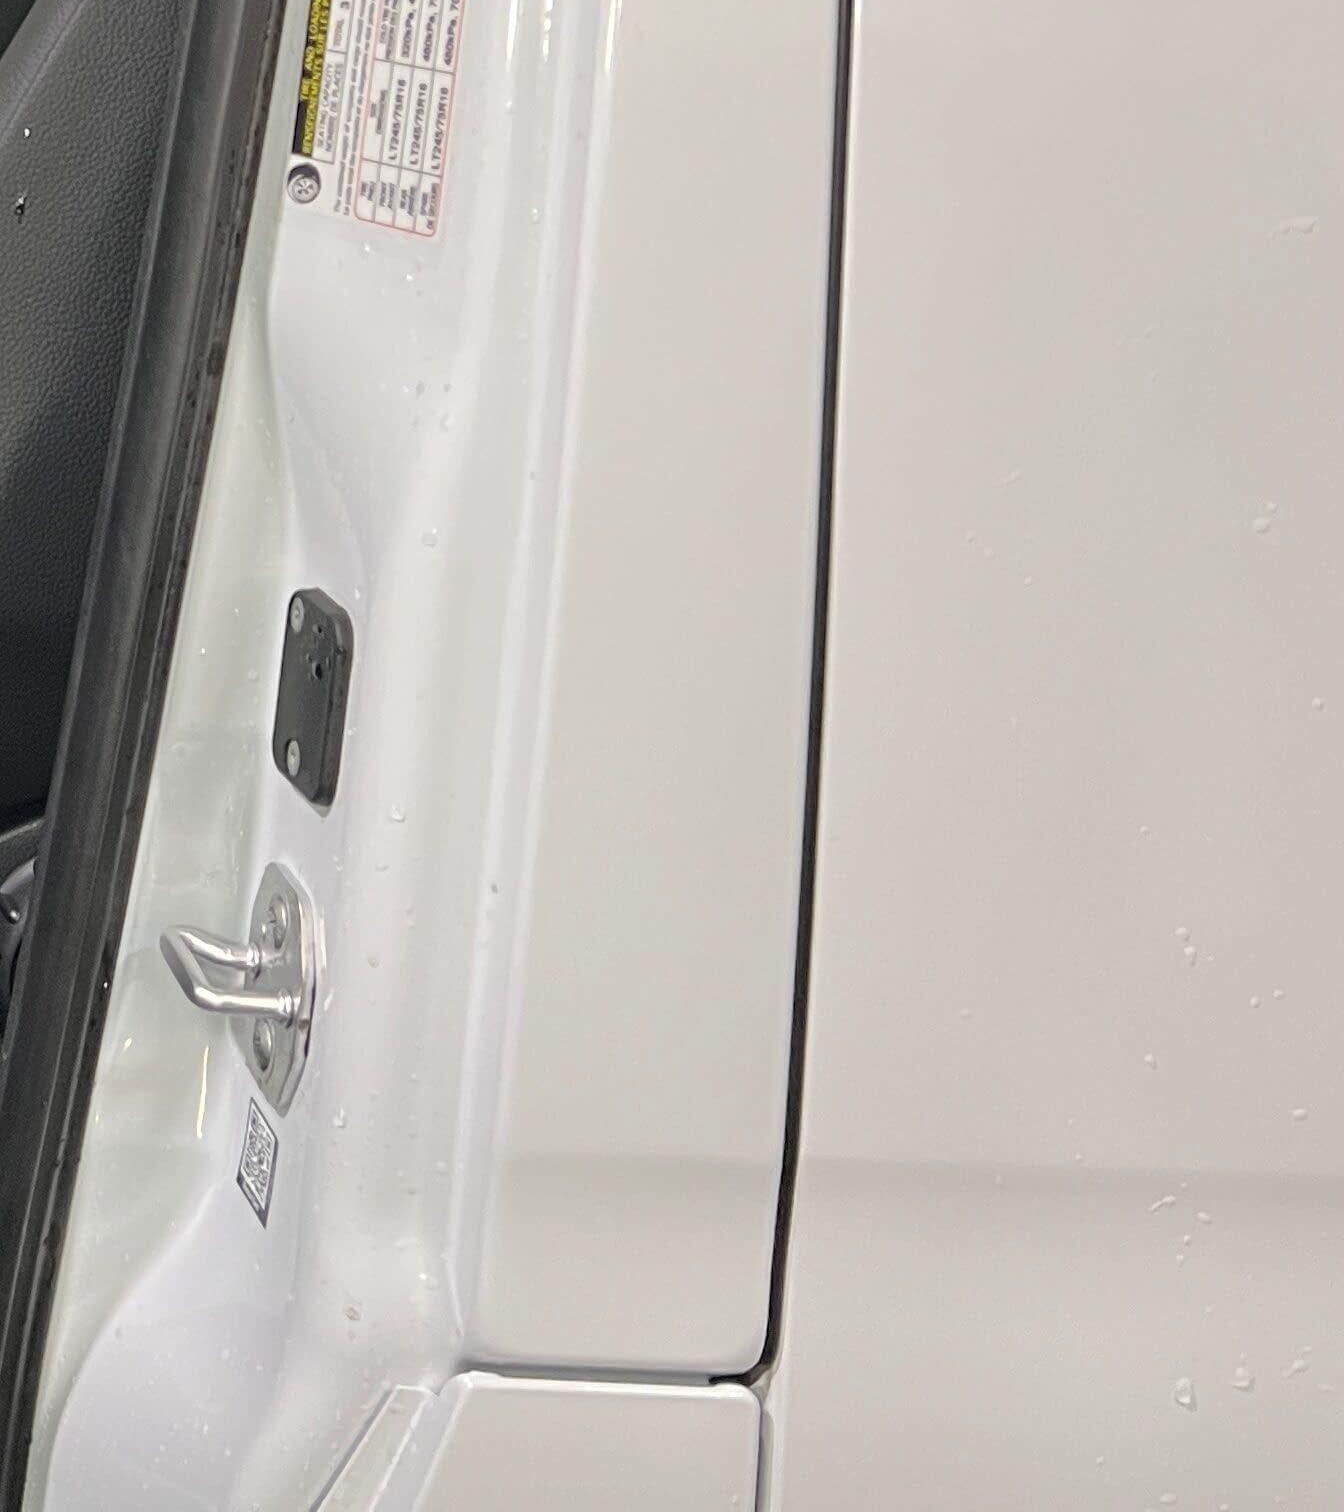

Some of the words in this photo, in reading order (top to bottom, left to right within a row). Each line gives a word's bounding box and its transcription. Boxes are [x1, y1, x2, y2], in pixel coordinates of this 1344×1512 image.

[302, 44, 315, 71] AND
[387, 78, 406, 160] LT245/75R16
[408, 82, 428, 165] LT245/75R16
[429, 86, 450, 170] LT245/75R16
